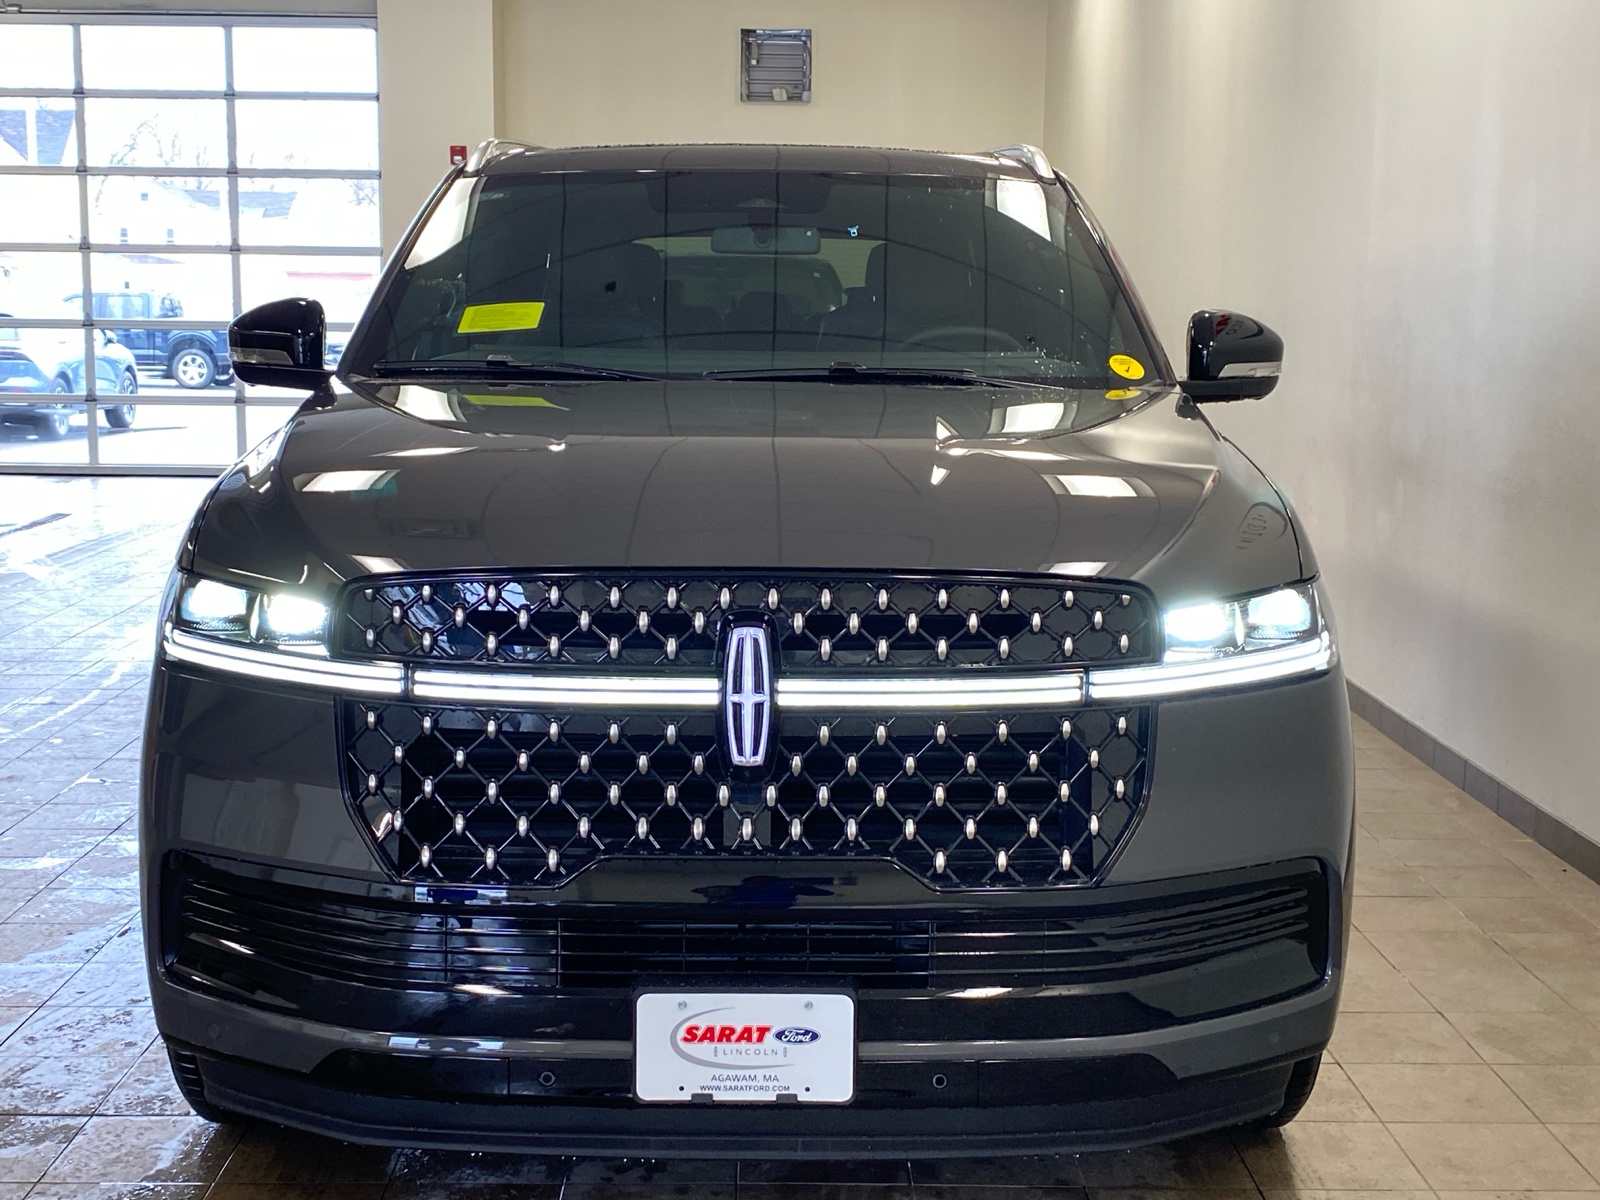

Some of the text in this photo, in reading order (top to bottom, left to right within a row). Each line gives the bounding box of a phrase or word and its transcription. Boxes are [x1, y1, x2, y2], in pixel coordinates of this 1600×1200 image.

[681, 1024, 812, 1044] SARAT Ford
[723, 1048, 778, 1056] LINCOLN
[710, 1074, 780, 1083] AGAWAM, MA
